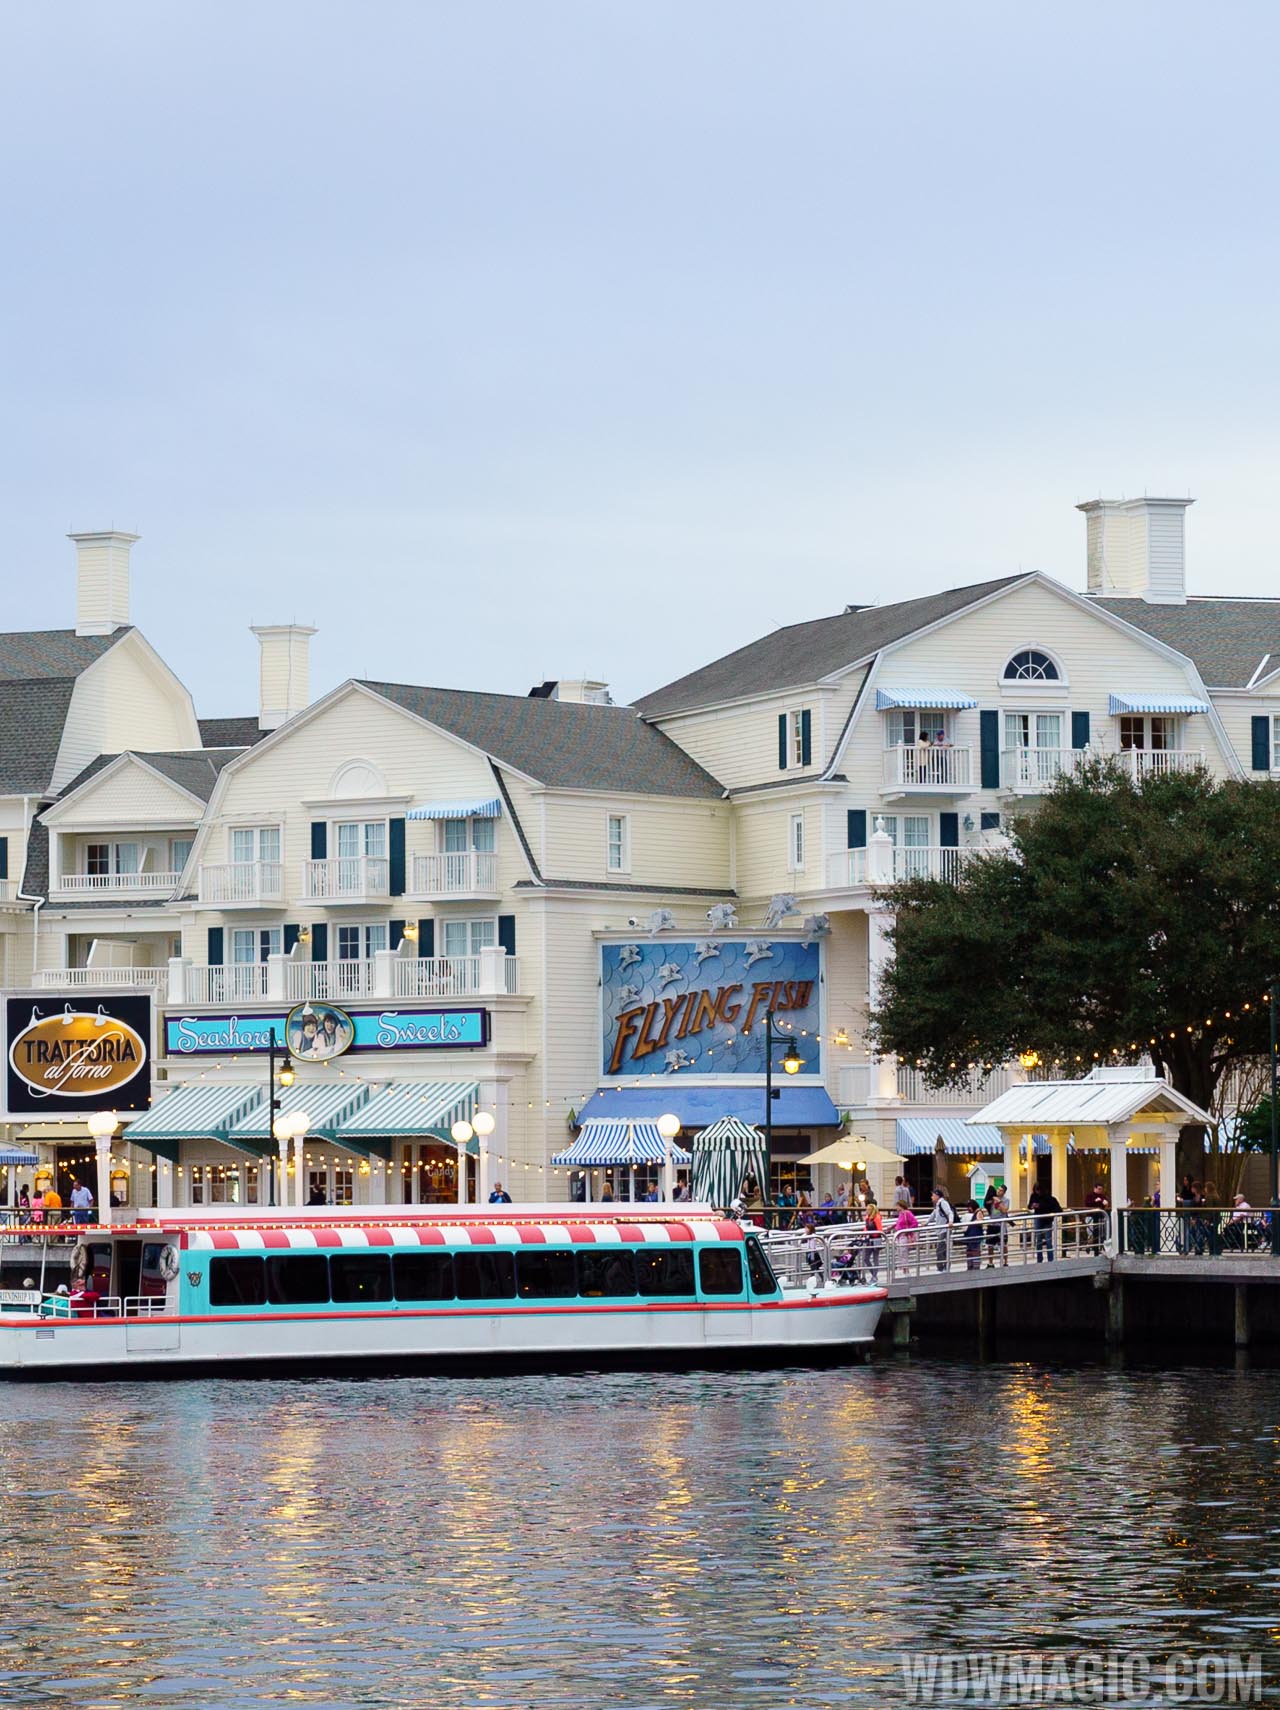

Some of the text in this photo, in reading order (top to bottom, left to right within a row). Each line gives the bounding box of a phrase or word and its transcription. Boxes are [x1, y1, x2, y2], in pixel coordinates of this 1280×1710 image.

[178, 1012, 468, 1053] Seashore Sweets'
[608, 981, 815, 1075] FLYING FISH
[23, 1038, 137, 1064] TRATTORIA
